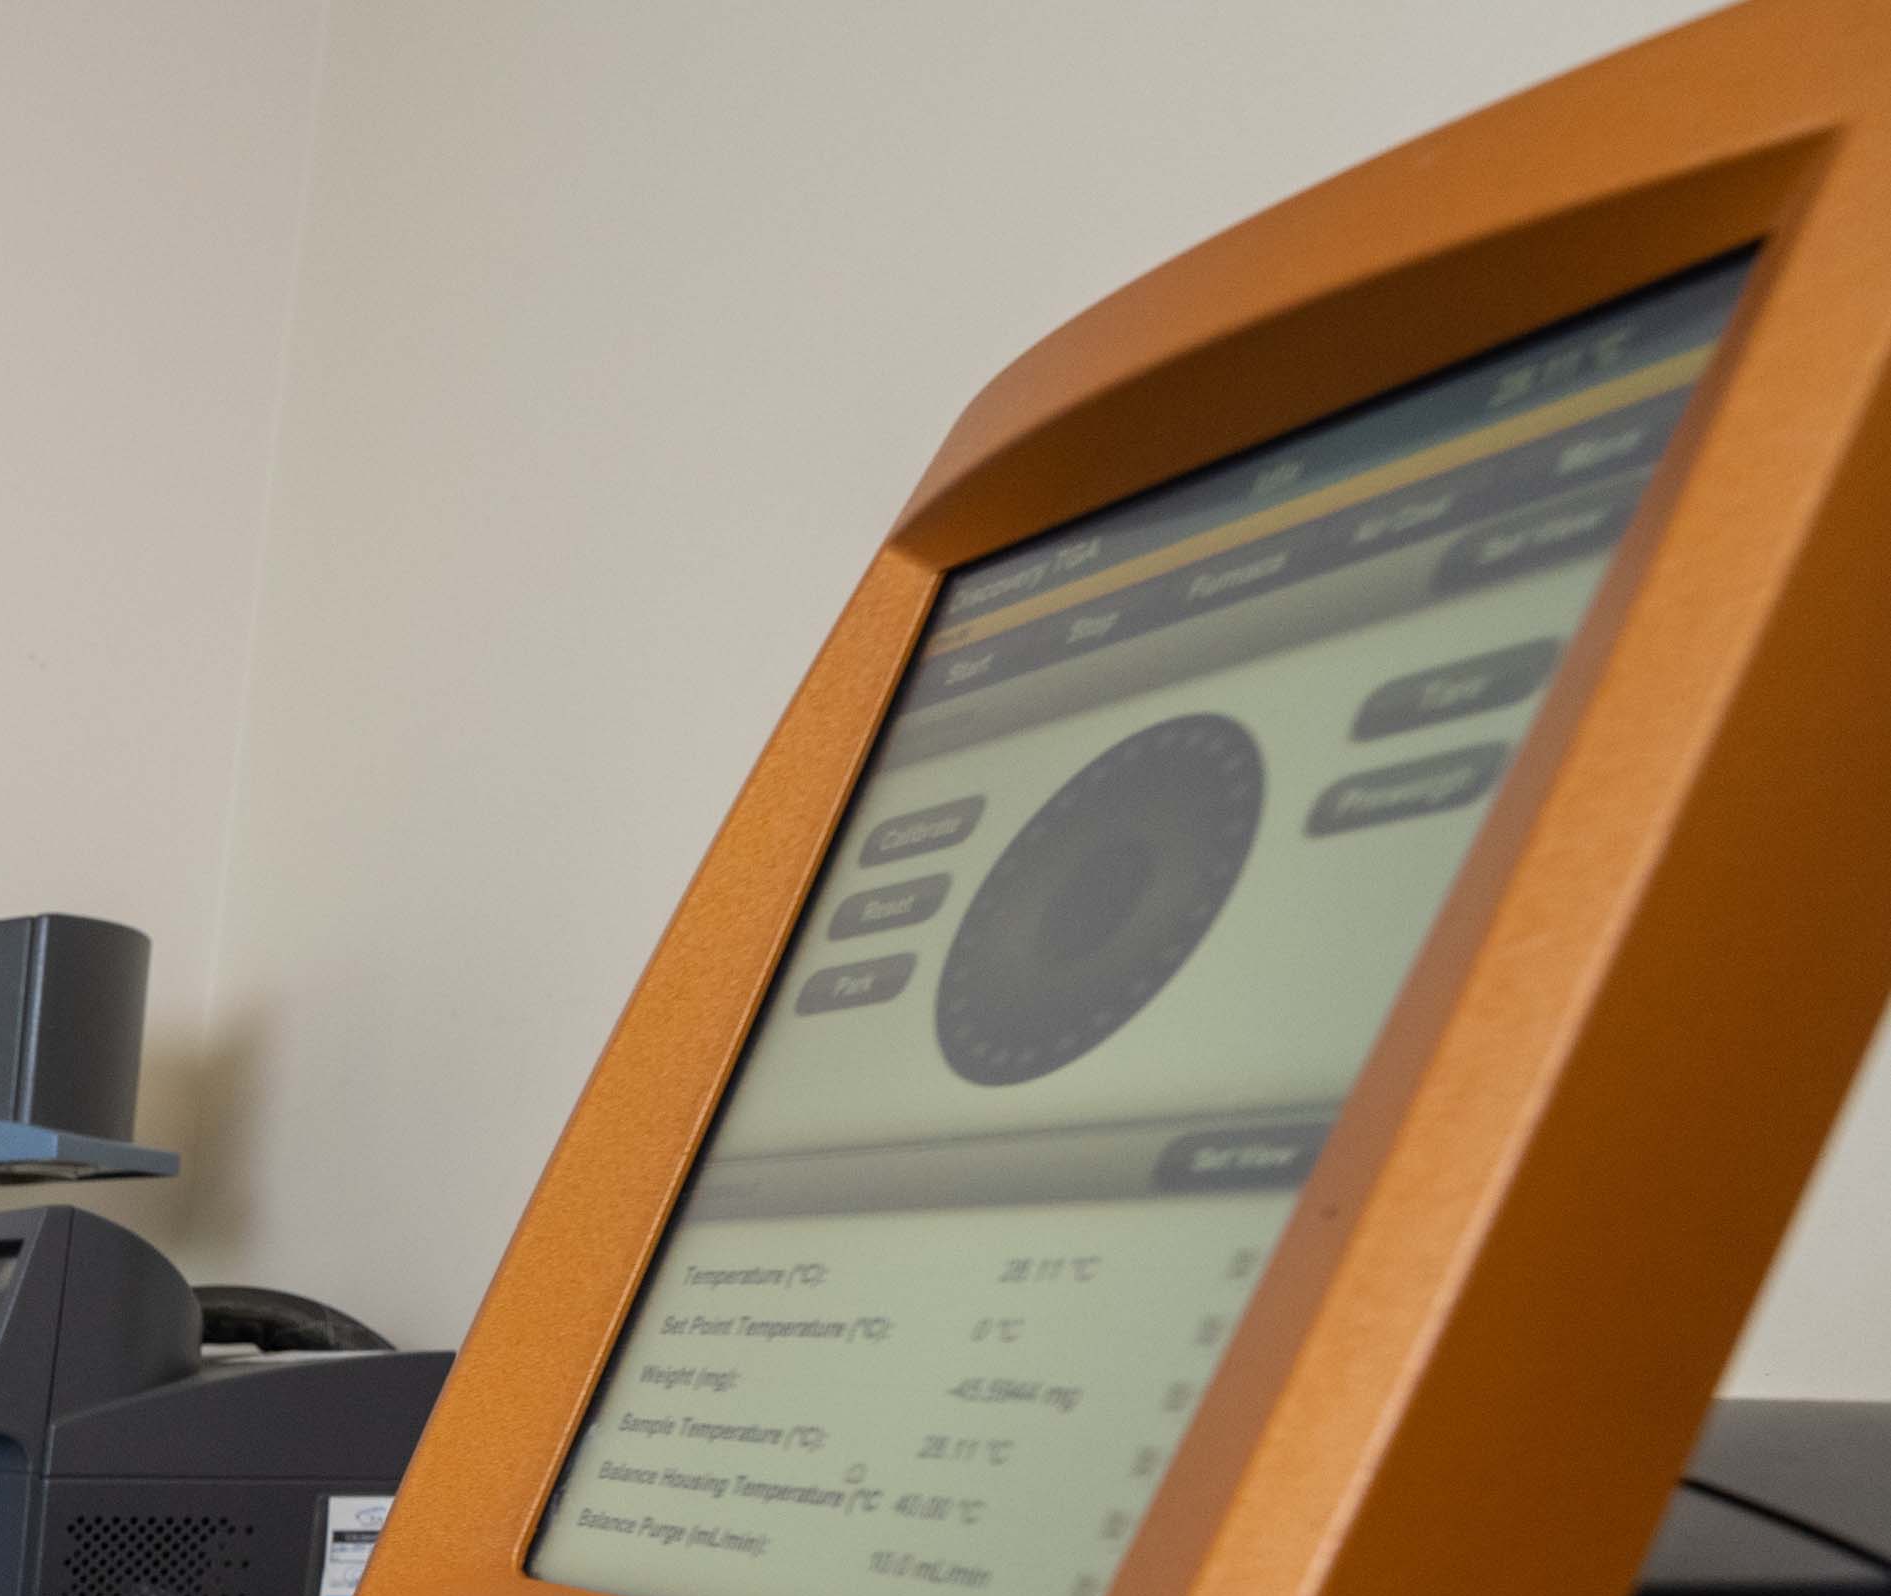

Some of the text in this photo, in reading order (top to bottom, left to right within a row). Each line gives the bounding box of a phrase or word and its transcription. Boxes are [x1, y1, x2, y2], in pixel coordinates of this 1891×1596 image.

[687, 1266, 786, 1287] Temperature
[739, 1316, 848, 1339] Temperature
[640, 1365, 697, 1390] Weight
[619, 1412, 676, 1437] Sample
[681, 1417, 784, 1445] Temperature
[598, 1460, 660, 1485] Balance
[659, 1469, 729, 1499] Housing
[734, 1475, 845, 1507] Temperature
[577, 1508, 639, 1534] Balance
[638, 1516, 687, 1545] Purge
